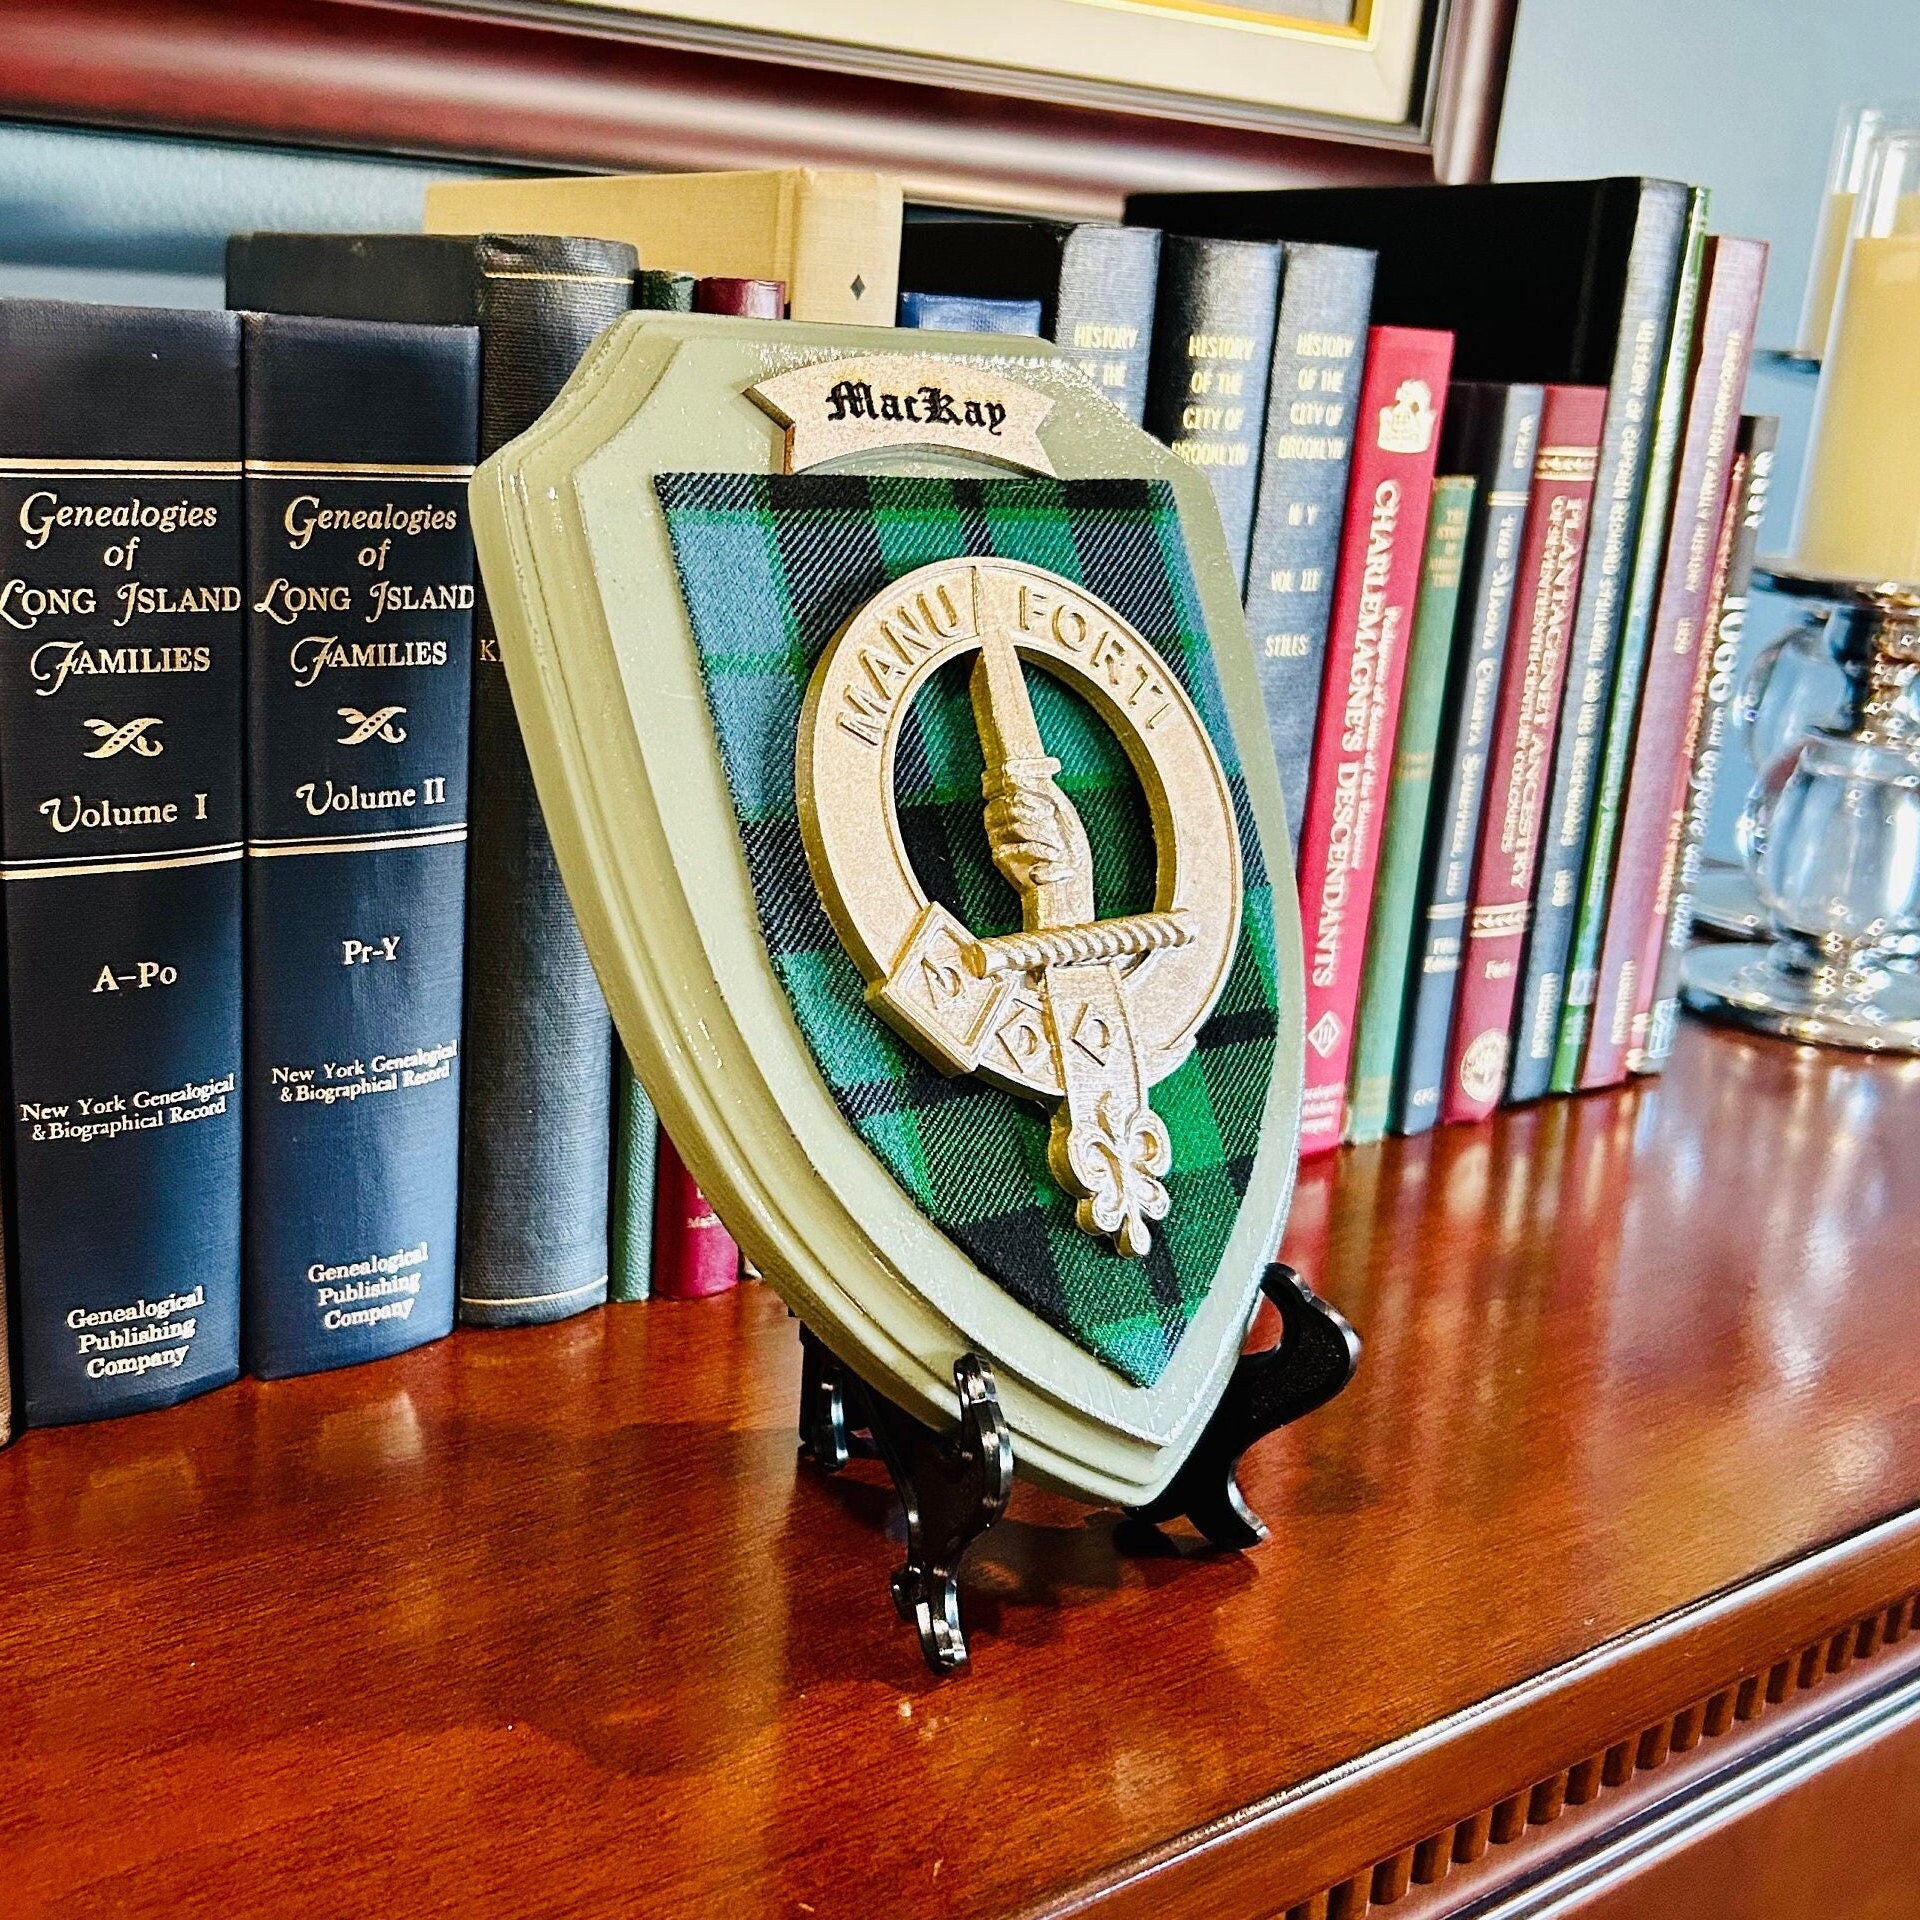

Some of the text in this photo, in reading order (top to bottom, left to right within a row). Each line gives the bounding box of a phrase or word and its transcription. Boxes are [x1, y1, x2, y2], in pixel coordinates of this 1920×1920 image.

[1073, 324, 1138, 349] HISTORY
[1189, 335, 1255, 360] HISTORY
[1297, 333, 1356, 357] HISTORY
[1103, 362, 1127, 387] THE
[1190, 370, 1243, 395] OF THE
[1298, 367, 1344, 392] OF THE
[826, 380, 1006, 436] MacKay
[1183, 405, 1245, 431] CITY OF
[1290, 402, 1344, 426] CITY OF
[1278, 435, 1347, 459] BROOKLYN
[19, 491, 217, 549] Genealogies
[284, 495, 457, 552] Genealogies
[1549, 495, 1568, 521] OF
[104, 537, 140, 571] of
[357, 538, 391, 571] of
[1271, 569, 1294, 592] VOL
[0, 579, 241, 629] LONG ISLAND
[253, 578, 475, 625] LONG ISLAND
[289, 635, 448, 688] FAMILIES
[835, 583, 1173, 748] MANU FORTI
[1265, 635, 1311, 657] STILES
[30, 641, 211, 696] FAMILIES
[1511, 497, 1583, 888] PLANTAGENET ANCESTRY
[1312, 479, 1400, 987] CHARLEMAGNE'S DESCENDANTS
[40, 794, 208, 833] Volume I
[295, 777, 447, 817] Volume II
[342, 936, 401, 966] Pr-Y
[271, 1039, 457, 1085] New York Genealogical
[19, 1073, 236, 1122] New York Genealogical
[295, 1074, 398, 1105] Biographical
[402, 1061, 450, 1087] Record
[48, 1112, 165, 1143] Biographical
[169, 1096, 227, 1125] Record
[308, 1242, 429, 1283] Genealogical
[66, 1285, 205, 1330] Genealogical
[317, 1270, 421, 1307] Publishing
[324, 1298, 415, 1331] Company
[78, 1316, 197, 1356] Publishing
[86, 1343, 190, 1379] Company
